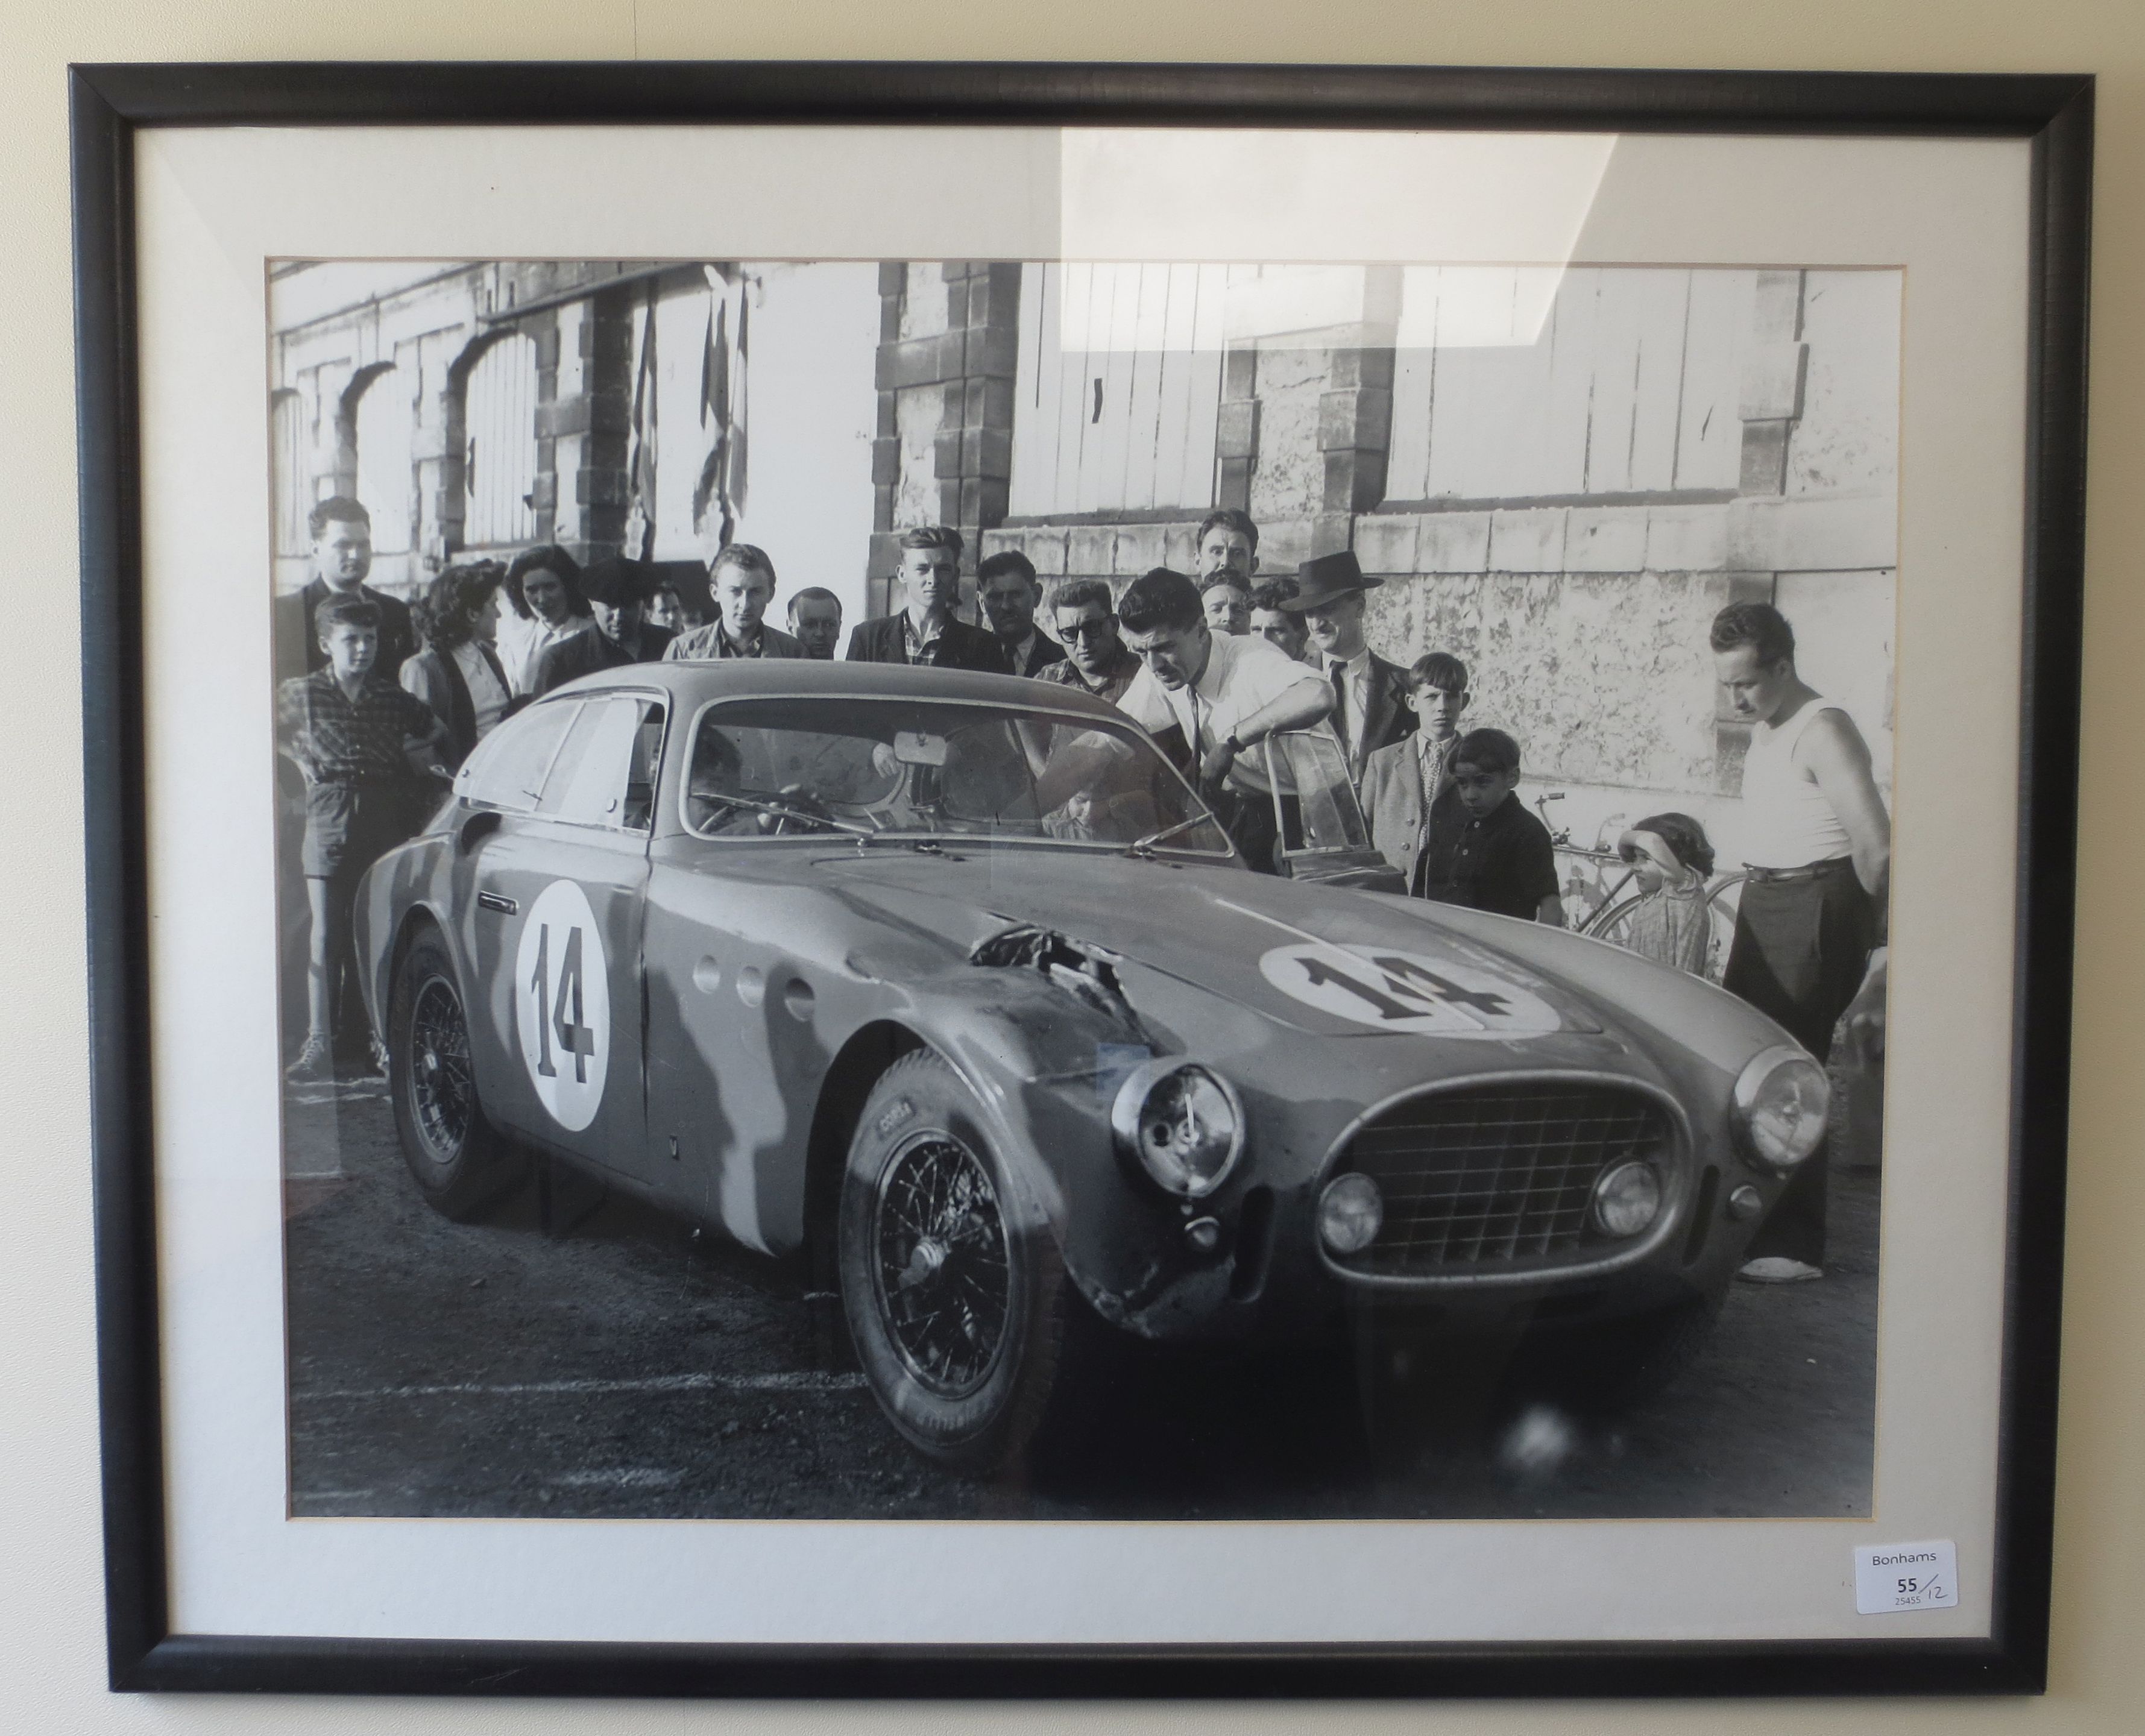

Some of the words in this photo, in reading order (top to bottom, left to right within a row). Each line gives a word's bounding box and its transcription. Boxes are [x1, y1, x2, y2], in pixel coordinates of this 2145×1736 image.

[532, 923, 594, 1083] 14
[1294, 957, 1512, 1020] 14
[1873, 1553, 1936, 1565] Bonhams
[1895, 1596, 1921, 1605] 25455
